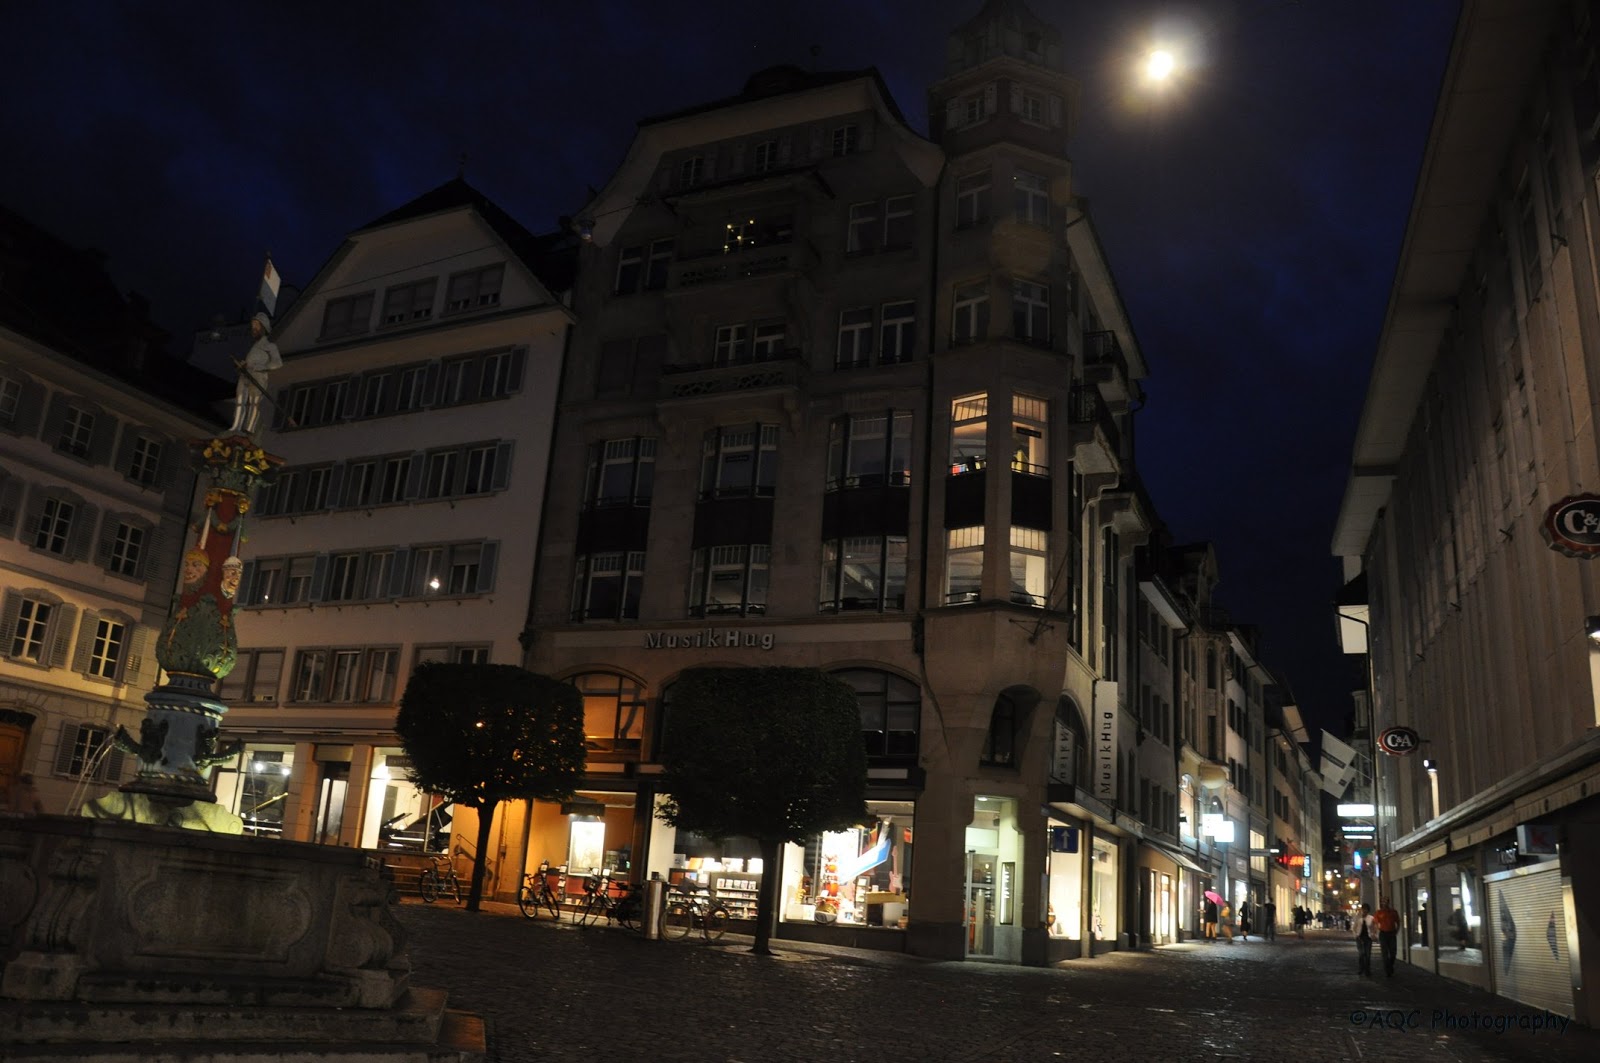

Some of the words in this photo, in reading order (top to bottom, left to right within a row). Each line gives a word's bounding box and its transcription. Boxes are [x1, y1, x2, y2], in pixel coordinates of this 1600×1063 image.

[1563, 508, 1600, 534] C&
[645, 628, 775, 650] MusikHug
[1387, 733, 1412, 747] C&A
[1100, 712, 1113, 794] MusikHug
